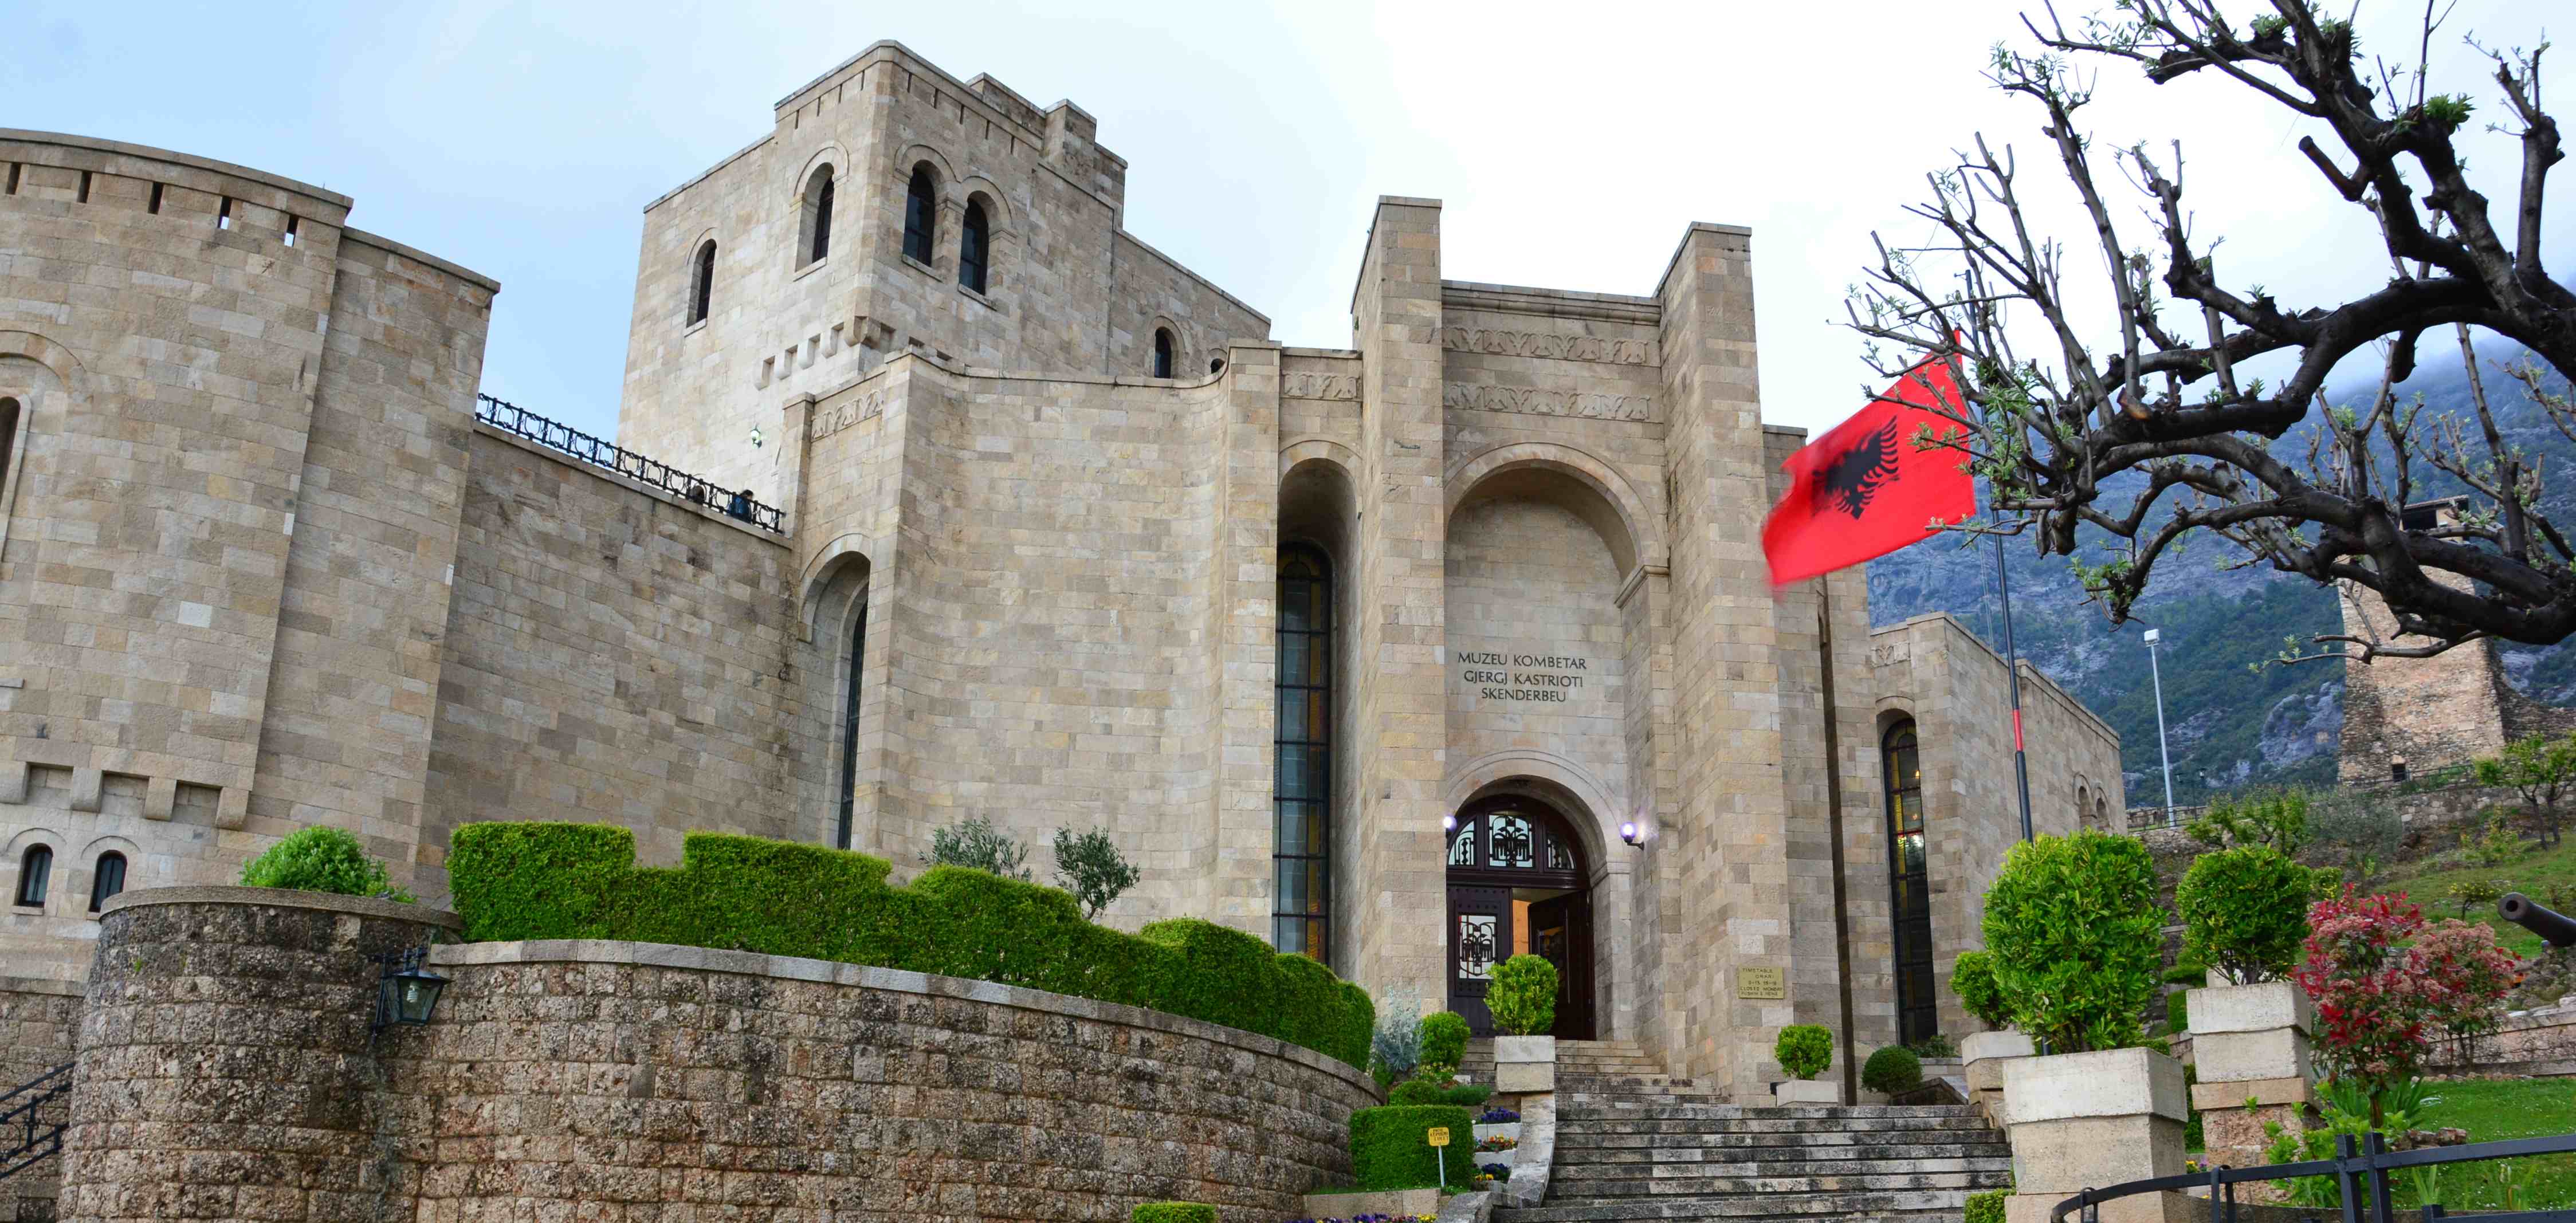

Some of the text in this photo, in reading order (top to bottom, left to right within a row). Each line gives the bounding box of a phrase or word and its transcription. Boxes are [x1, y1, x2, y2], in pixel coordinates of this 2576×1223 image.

[1458, 652, 1587, 669] MUZEU KOMBETAR
[1464, 671, 1583, 687] GJERGJ KASTRIOTI
[1481, 688, 1566, 702] SKENDERBEU
